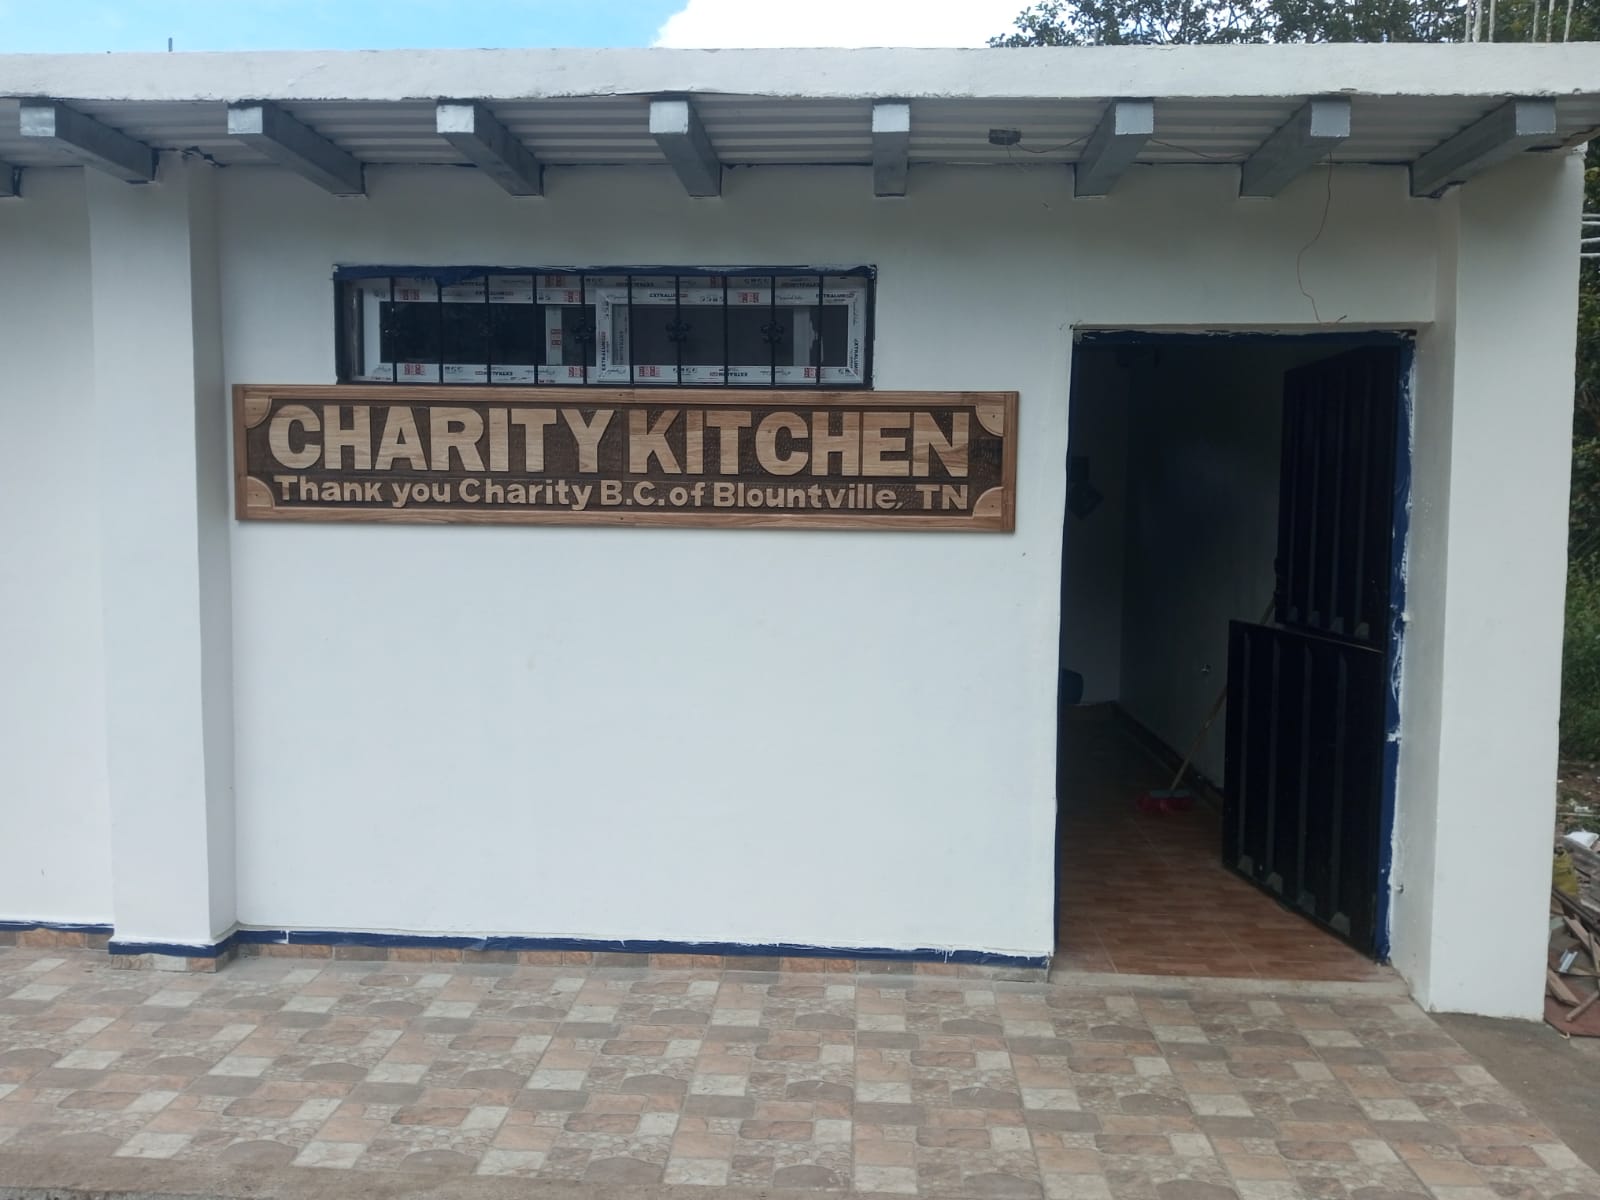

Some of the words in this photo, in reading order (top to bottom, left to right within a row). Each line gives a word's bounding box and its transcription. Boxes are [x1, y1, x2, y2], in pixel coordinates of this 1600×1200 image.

[268, 404, 615, 473] CHARITY
[628, 409, 970, 478] KITCHEN
[273, 475, 383, 502] Thank
[392, 482, 451, 508] you
[458, 478, 593, 511] Charity
[713, 481, 903, 509] Blountville,
[915, 484, 968, 510] TN
